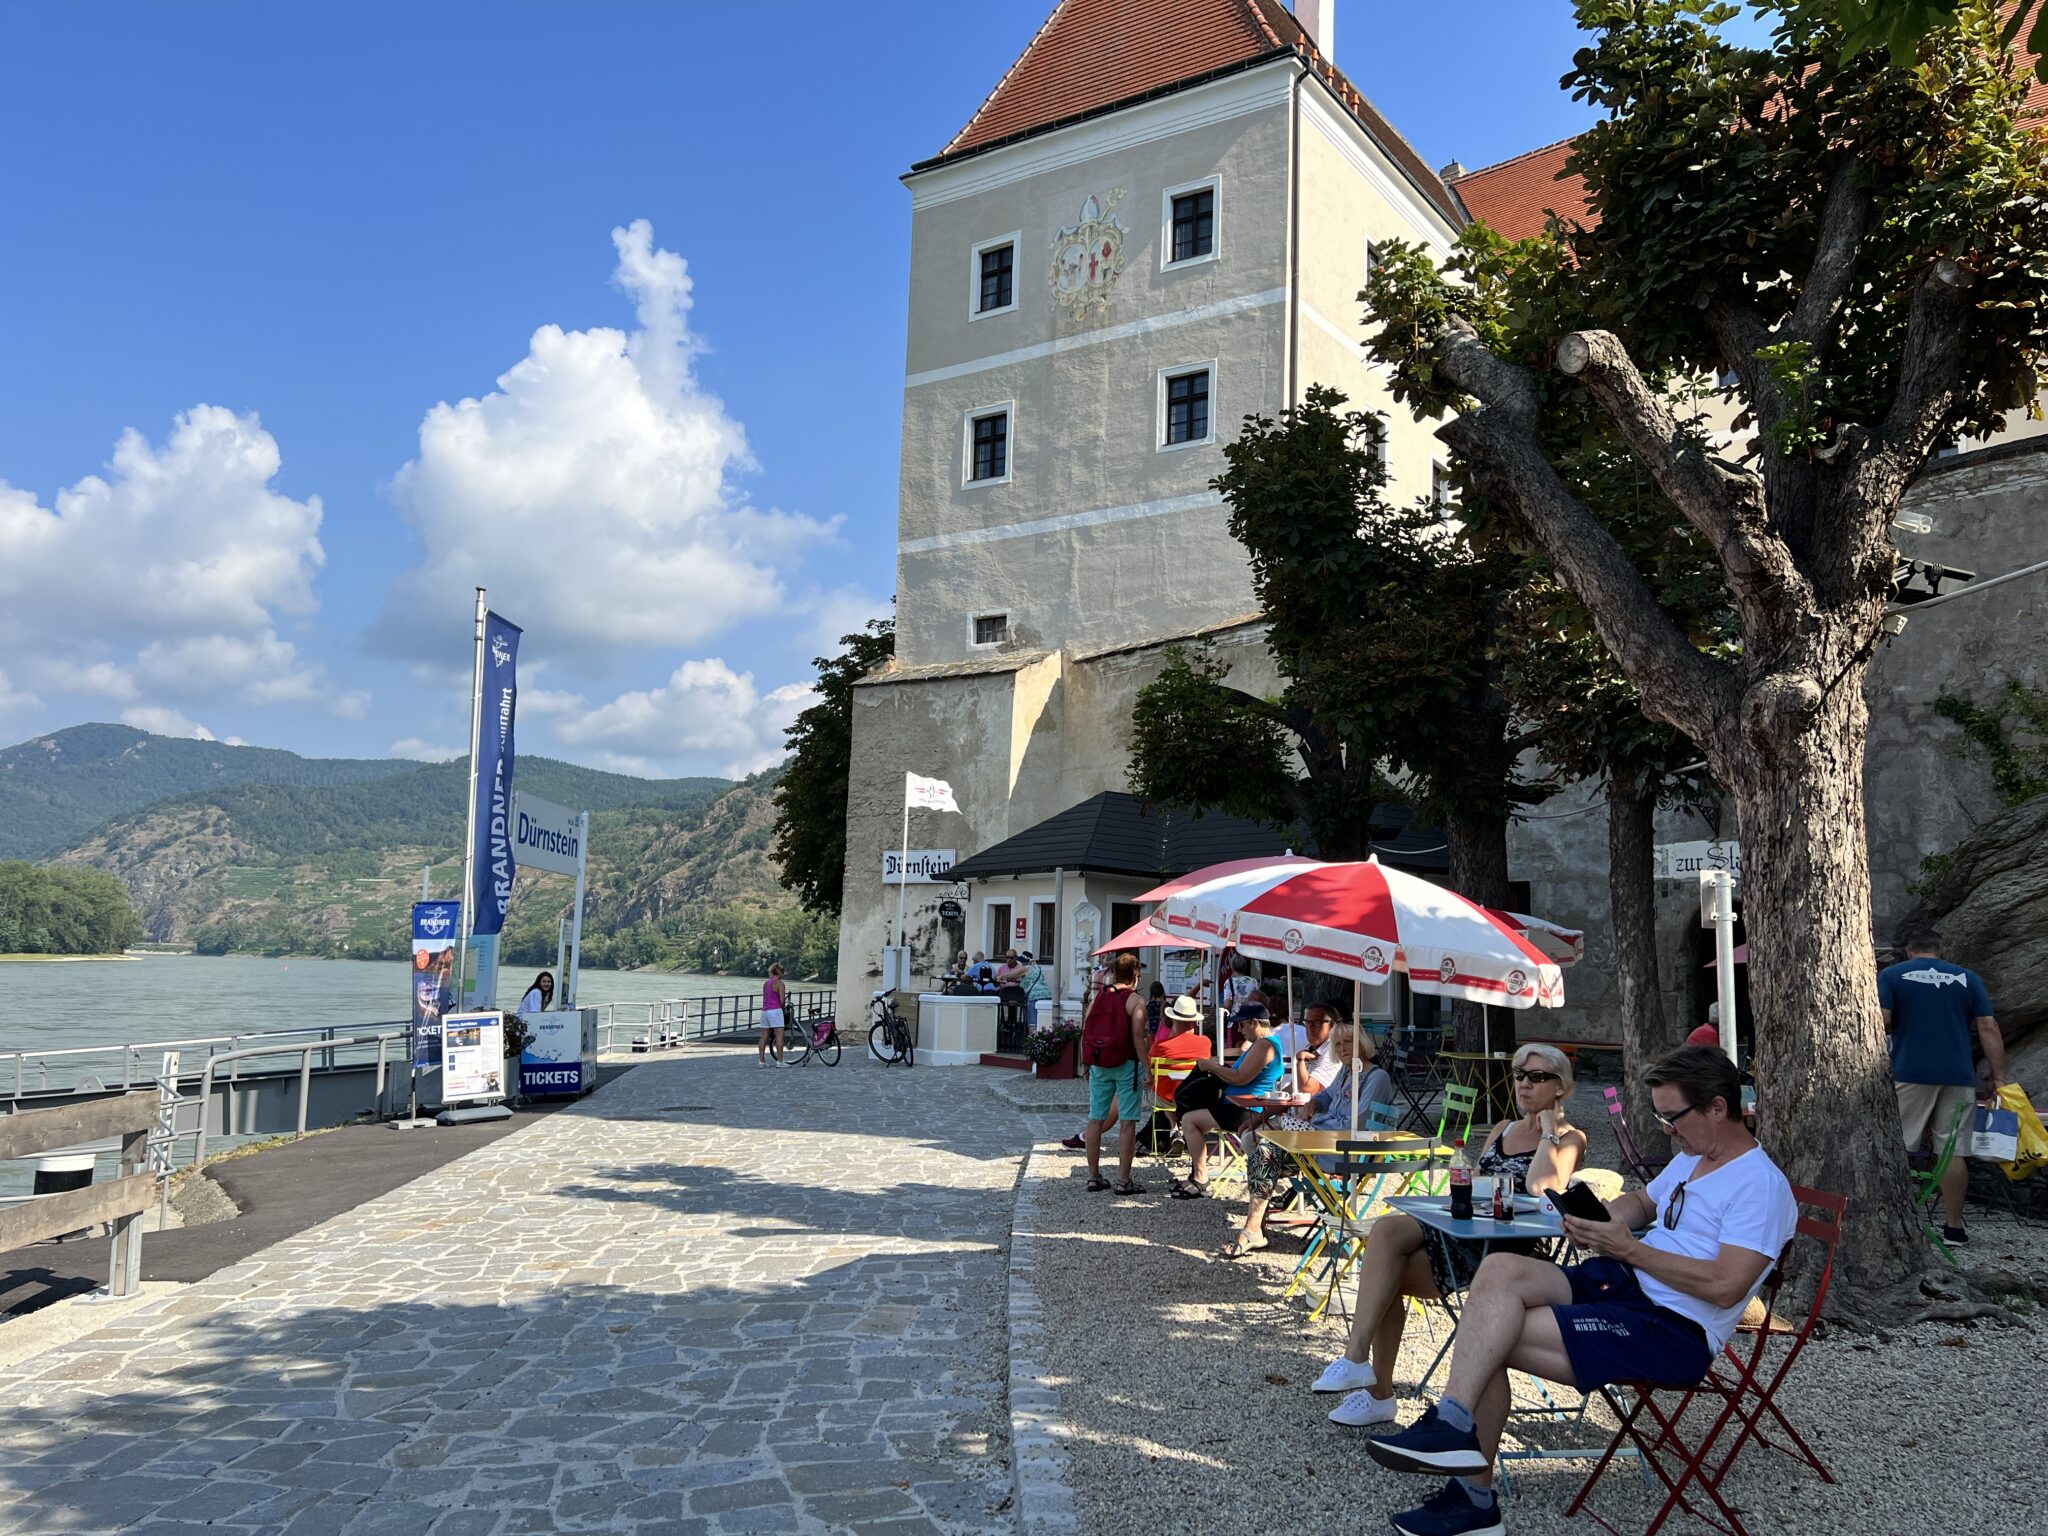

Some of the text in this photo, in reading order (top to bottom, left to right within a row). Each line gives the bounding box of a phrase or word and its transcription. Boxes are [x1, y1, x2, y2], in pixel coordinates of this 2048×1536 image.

[517, 811, 579, 858] Dürnstein
[1675, 857, 1704, 873] zur
[420, 918, 451, 926] BRANDNER
[1364, 953, 1381, 964] KAISER
[523, 1070, 579, 1086] TICKETS
